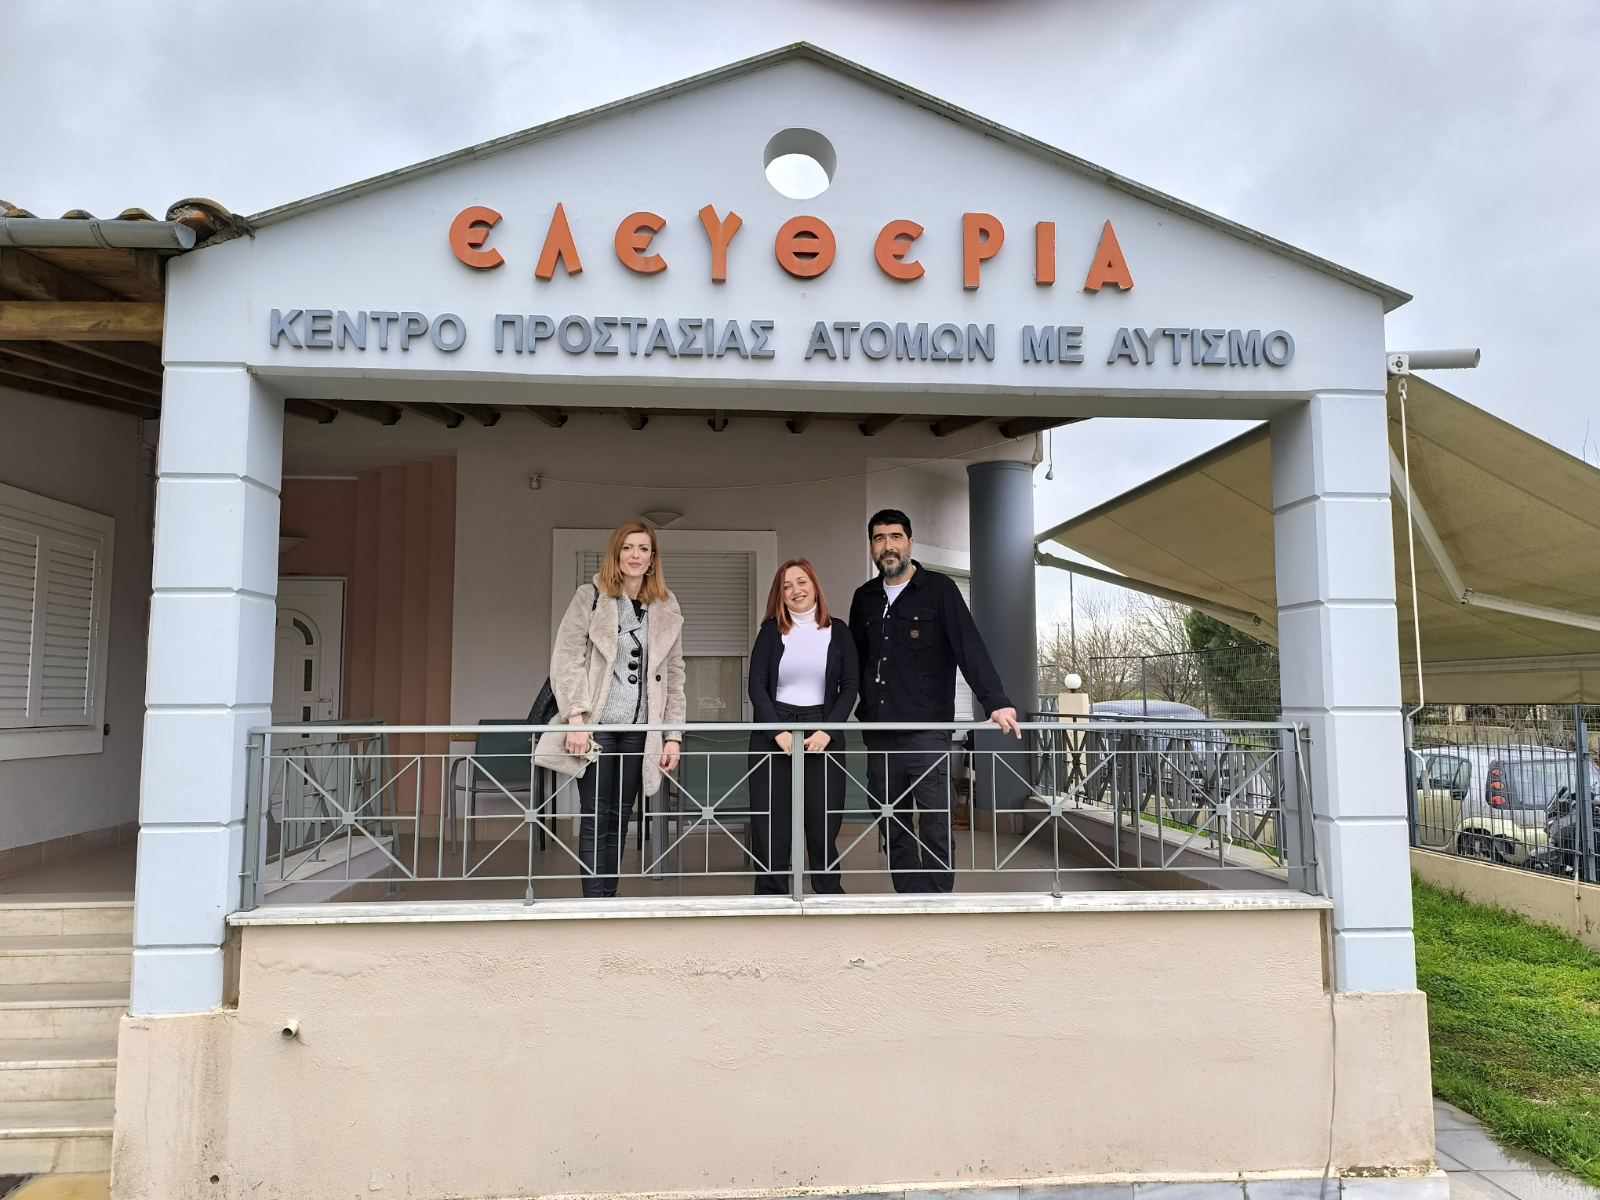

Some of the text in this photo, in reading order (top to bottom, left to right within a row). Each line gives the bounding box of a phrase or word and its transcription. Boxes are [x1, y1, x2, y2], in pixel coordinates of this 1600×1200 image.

[449, 202, 1133, 292] ΕΛΕΥΘΕΡΙΑ
[269, 308, 1296, 368] ΚΕΝΤΡΟ ΠΡΟΣΤΑΣΙΑΣ ΑΤΟΜΩΝ ΜΕ ΑΥΤΙΣΜΟ
